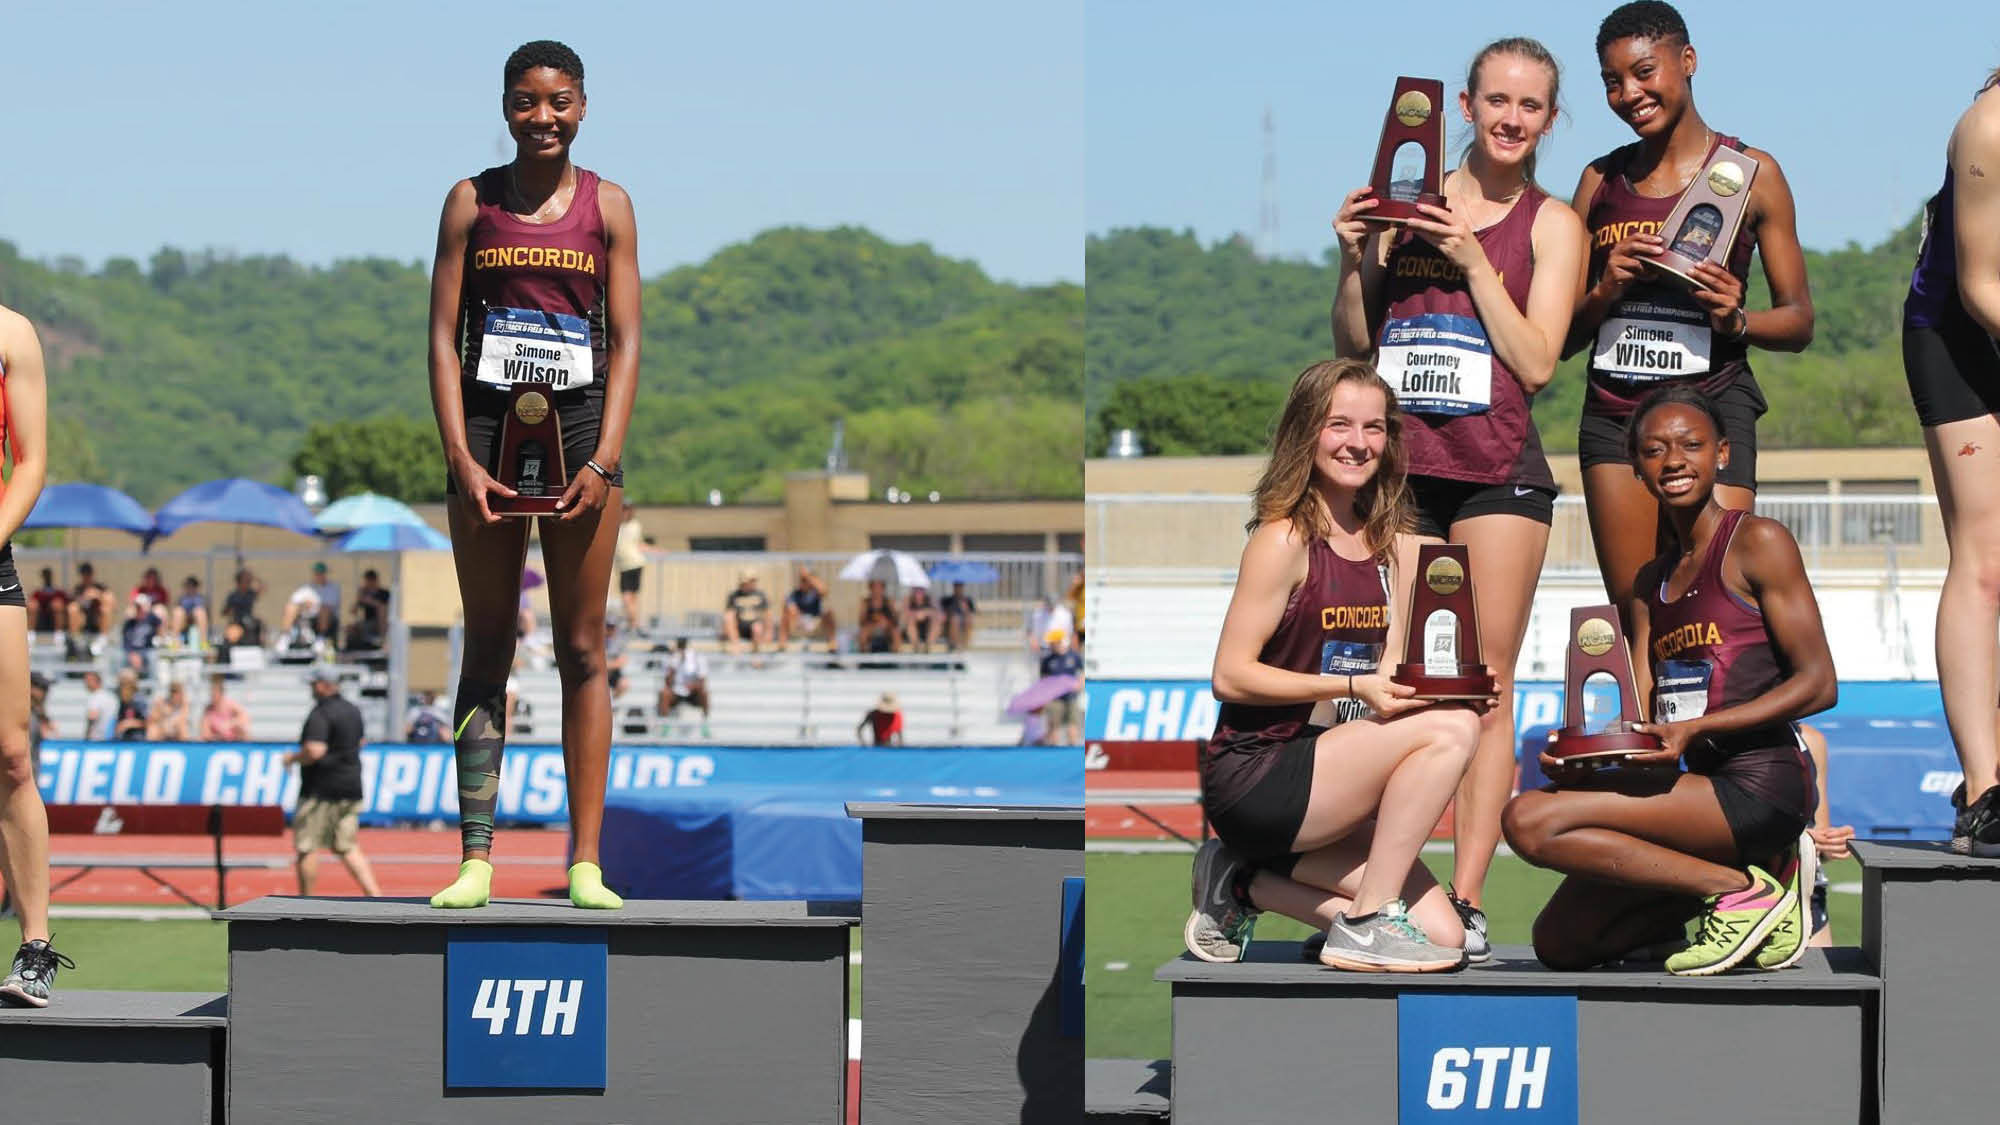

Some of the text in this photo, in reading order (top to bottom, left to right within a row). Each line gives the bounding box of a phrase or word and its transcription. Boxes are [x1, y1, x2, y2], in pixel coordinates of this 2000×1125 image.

[475, 247, 595, 275] CONCORDIA
[1625, 325, 1674, 342] Simone
[515, 344, 561, 360] Simone
[1407, 352, 1461, 369] Courtney
[1616, 343, 1682, 369] Wilson
[504, 359, 569, 386] Wilson
[1401, 370, 1461, 394] Lofink
[1321, 606, 1389, 629] CONCOR
[40, 749, 187, 806] FIELD
[471, 979, 583, 1035] 4TH
[1426, 1046, 1551, 1109] 6TH
